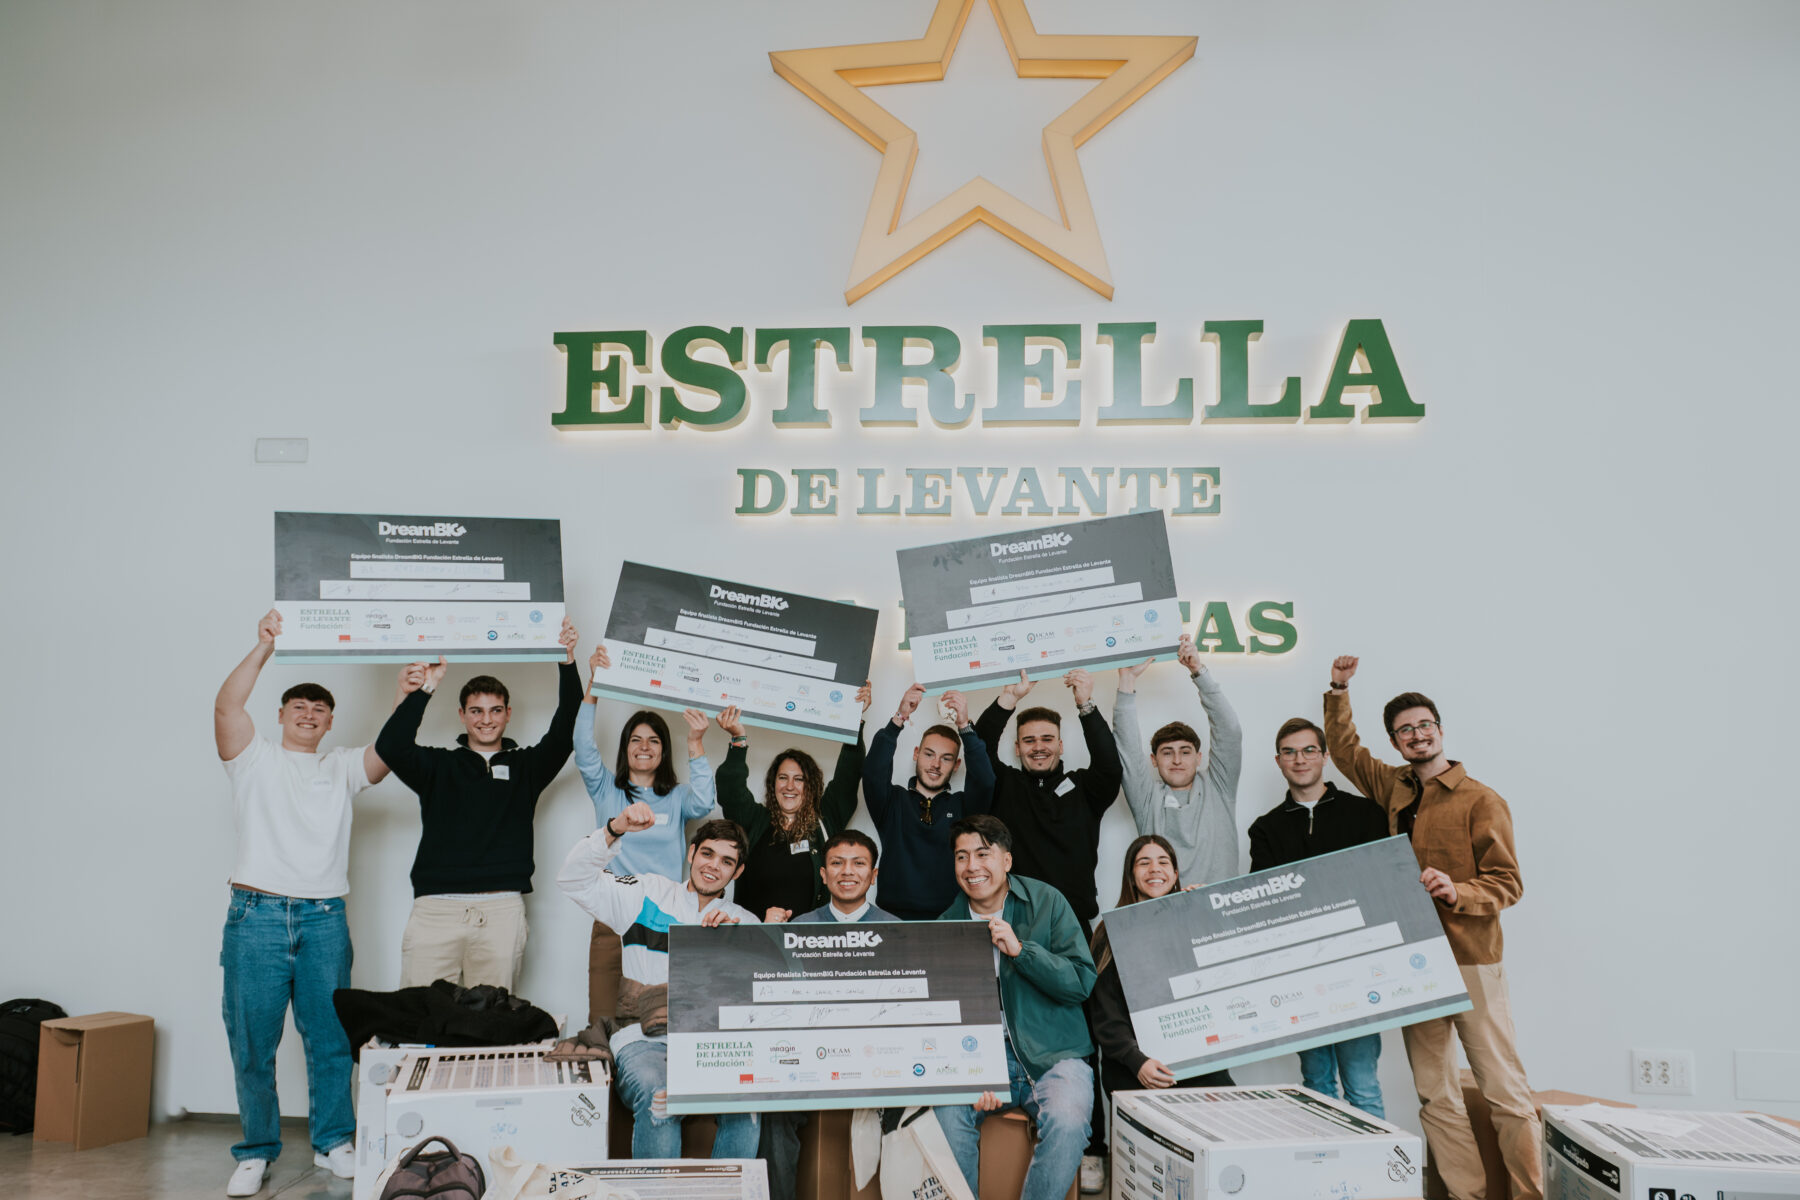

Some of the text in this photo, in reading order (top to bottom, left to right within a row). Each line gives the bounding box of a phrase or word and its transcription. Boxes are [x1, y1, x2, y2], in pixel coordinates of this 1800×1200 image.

[551, 318, 1426, 432] ESTRELLA
[735, 466, 1221, 517] DE LEVANTE
[378, 521, 467, 537] DreamBIG
[990, 532, 1073, 557] DreamBIG
[709, 584, 789, 611] DreamBIG
[1209, 872, 1306, 910] DreamBIG
[784, 931, 883, 949] DreamBIG
[753, 972, 776, 980] Equipo
[802, 970, 834, 978] DreamBIG
[834, 969, 867, 977] Fundación
[867, 969, 891, 977] Estrella
[901, 968, 926, 976] Levante
[1158, 1004, 1211, 1023] ESTRELLA
[1160, 1013, 1213, 1031] DE LEVANTE
[696, 1041, 753, 1050] ESTRELLA
[711, 1050, 754, 1058] LEVANTE
[696, 1059, 745, 1068] Fundación
